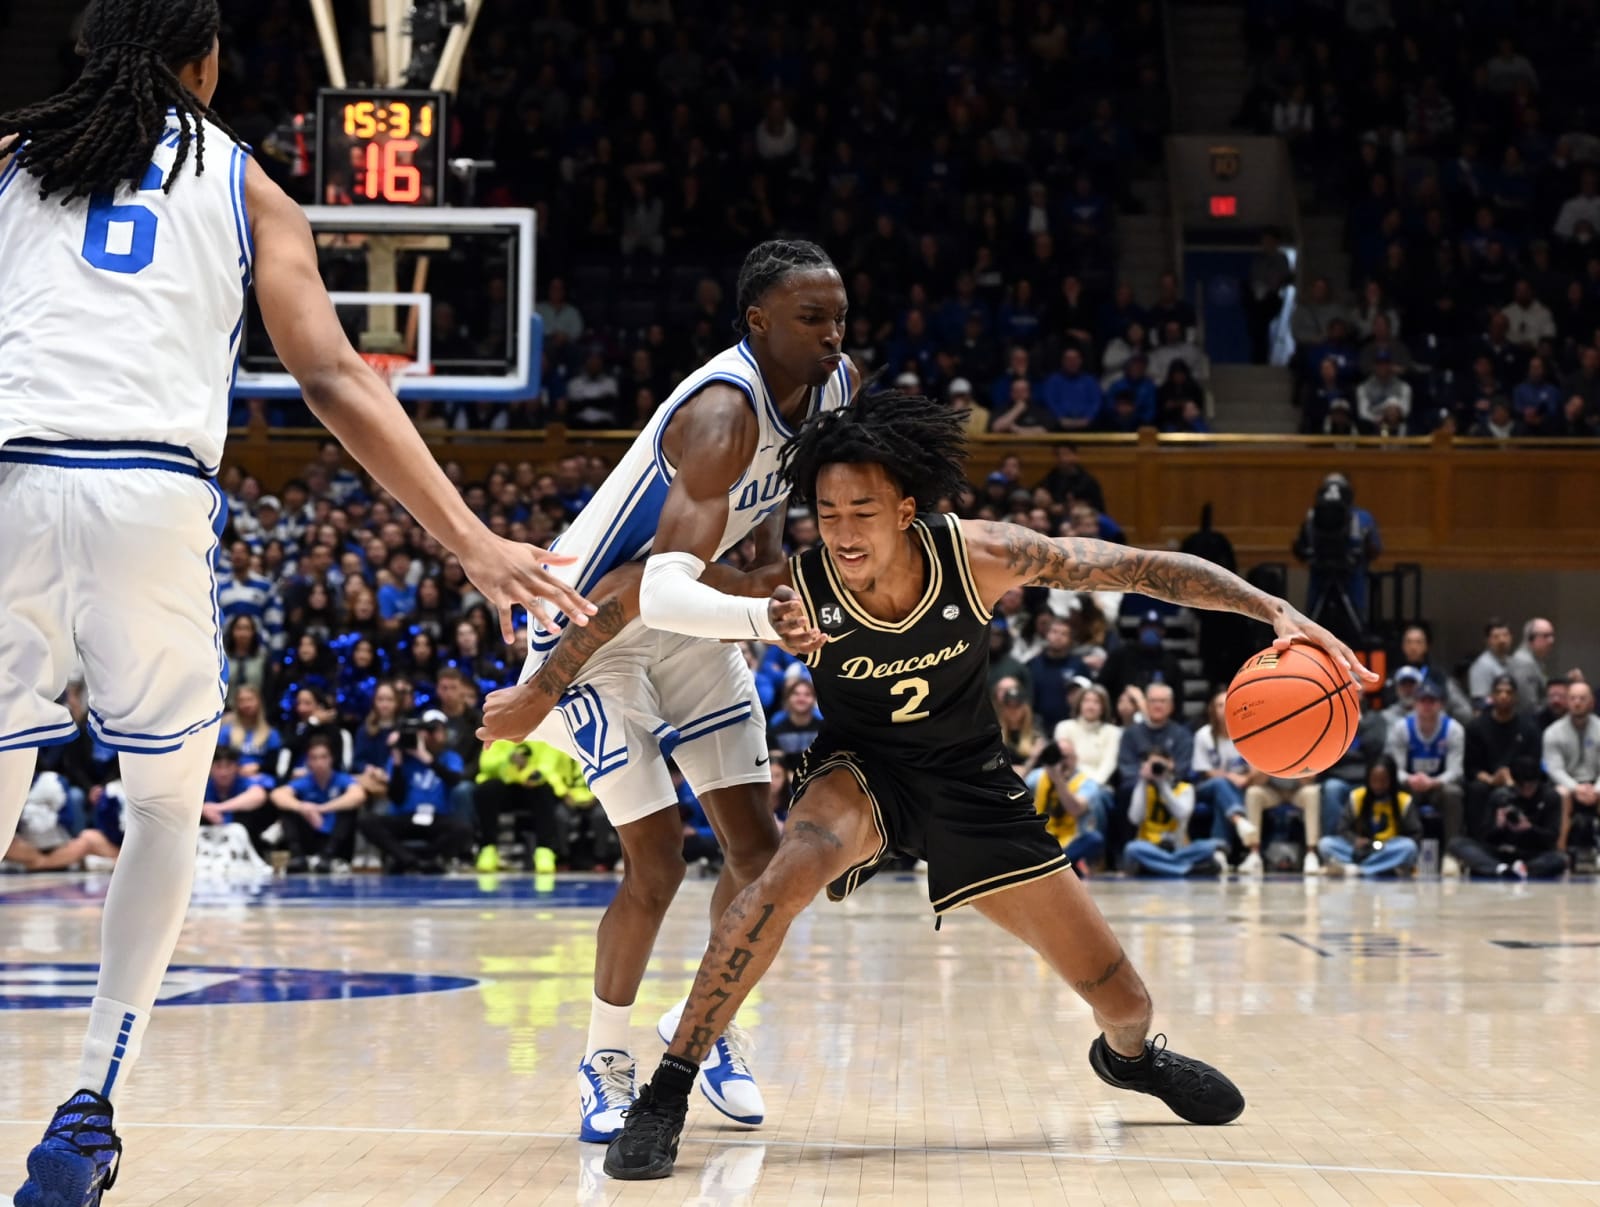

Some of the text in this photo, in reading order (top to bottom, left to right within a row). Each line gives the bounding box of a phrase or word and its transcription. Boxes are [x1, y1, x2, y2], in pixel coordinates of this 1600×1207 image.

[344, 101, 432, 139] 15:31
[365, 140, 421, 202] 16
[81, 160, 164, 274] 6
[735, 470, 790, 511] DU
[821, 607, 842, 624] 54
[837, 639, 970, 680] Deacons
[890, 676, 930, 723] 2
[683, 903, 775, 1061] 1978
